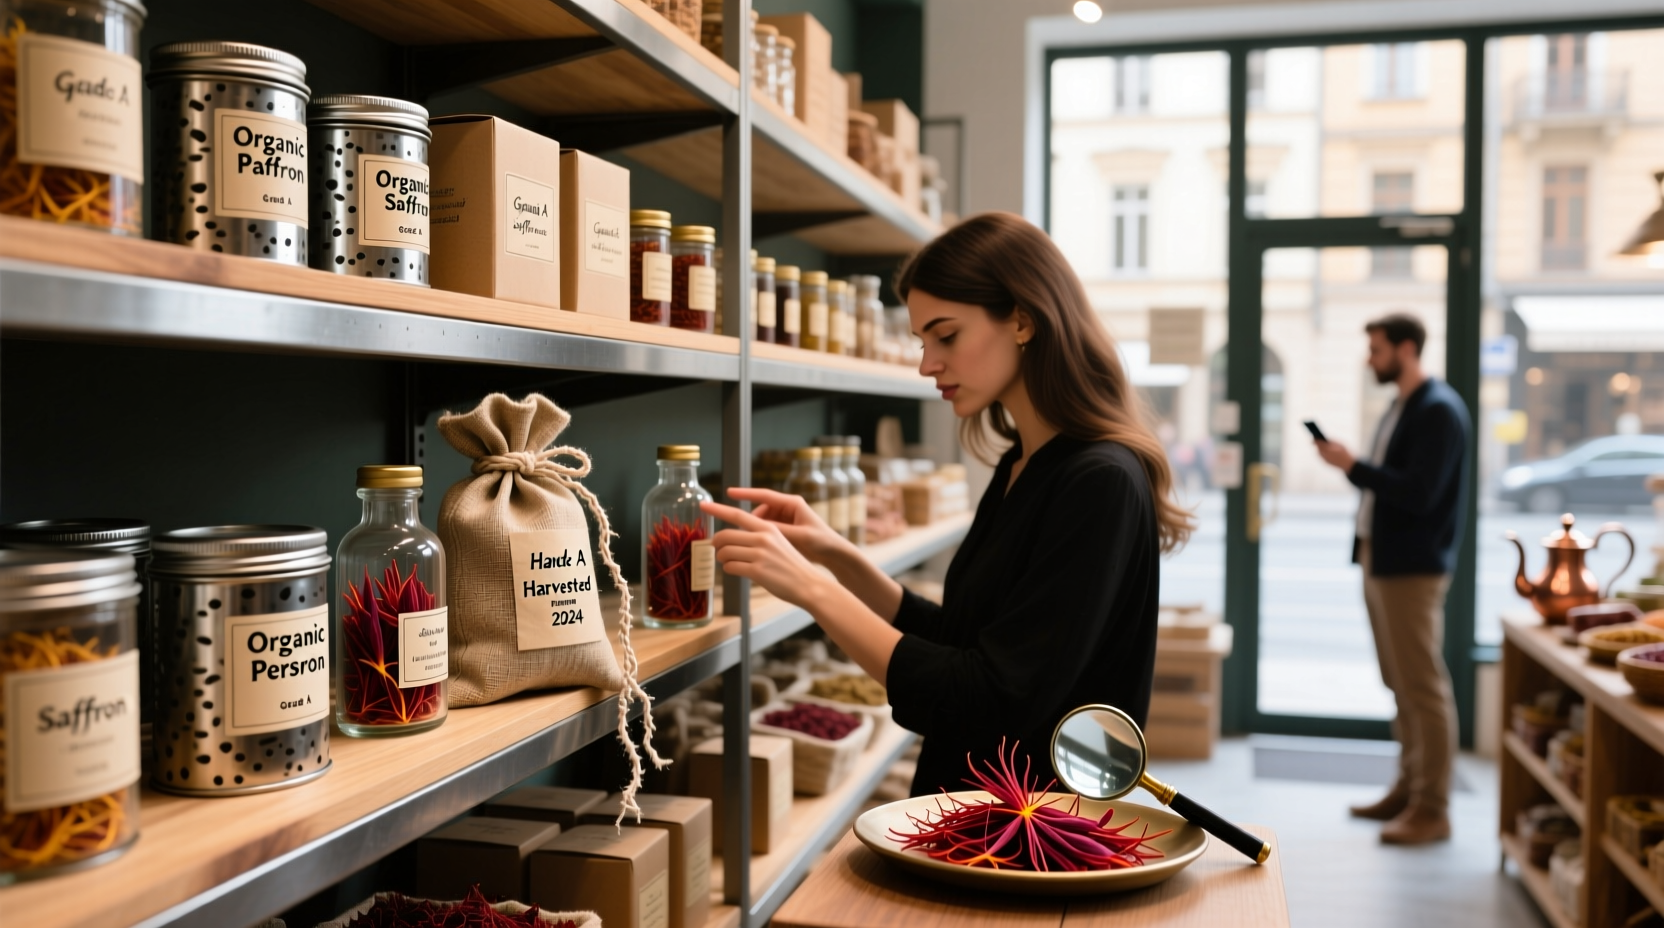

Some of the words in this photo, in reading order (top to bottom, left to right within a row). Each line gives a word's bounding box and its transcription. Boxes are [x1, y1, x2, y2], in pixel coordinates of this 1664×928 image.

[233, 126, 304, 158] Organic
[238, 153, 304, 184] Paffron
[576, 548, 587, 567] A
[523, 575, 591, 598] Harvested
[551, 608, 585, 627] 2024
[247, 623, 325, 657] Organic
[252, 656, 325, 682] Persron
[37, 695, 126, 736] Saffron
